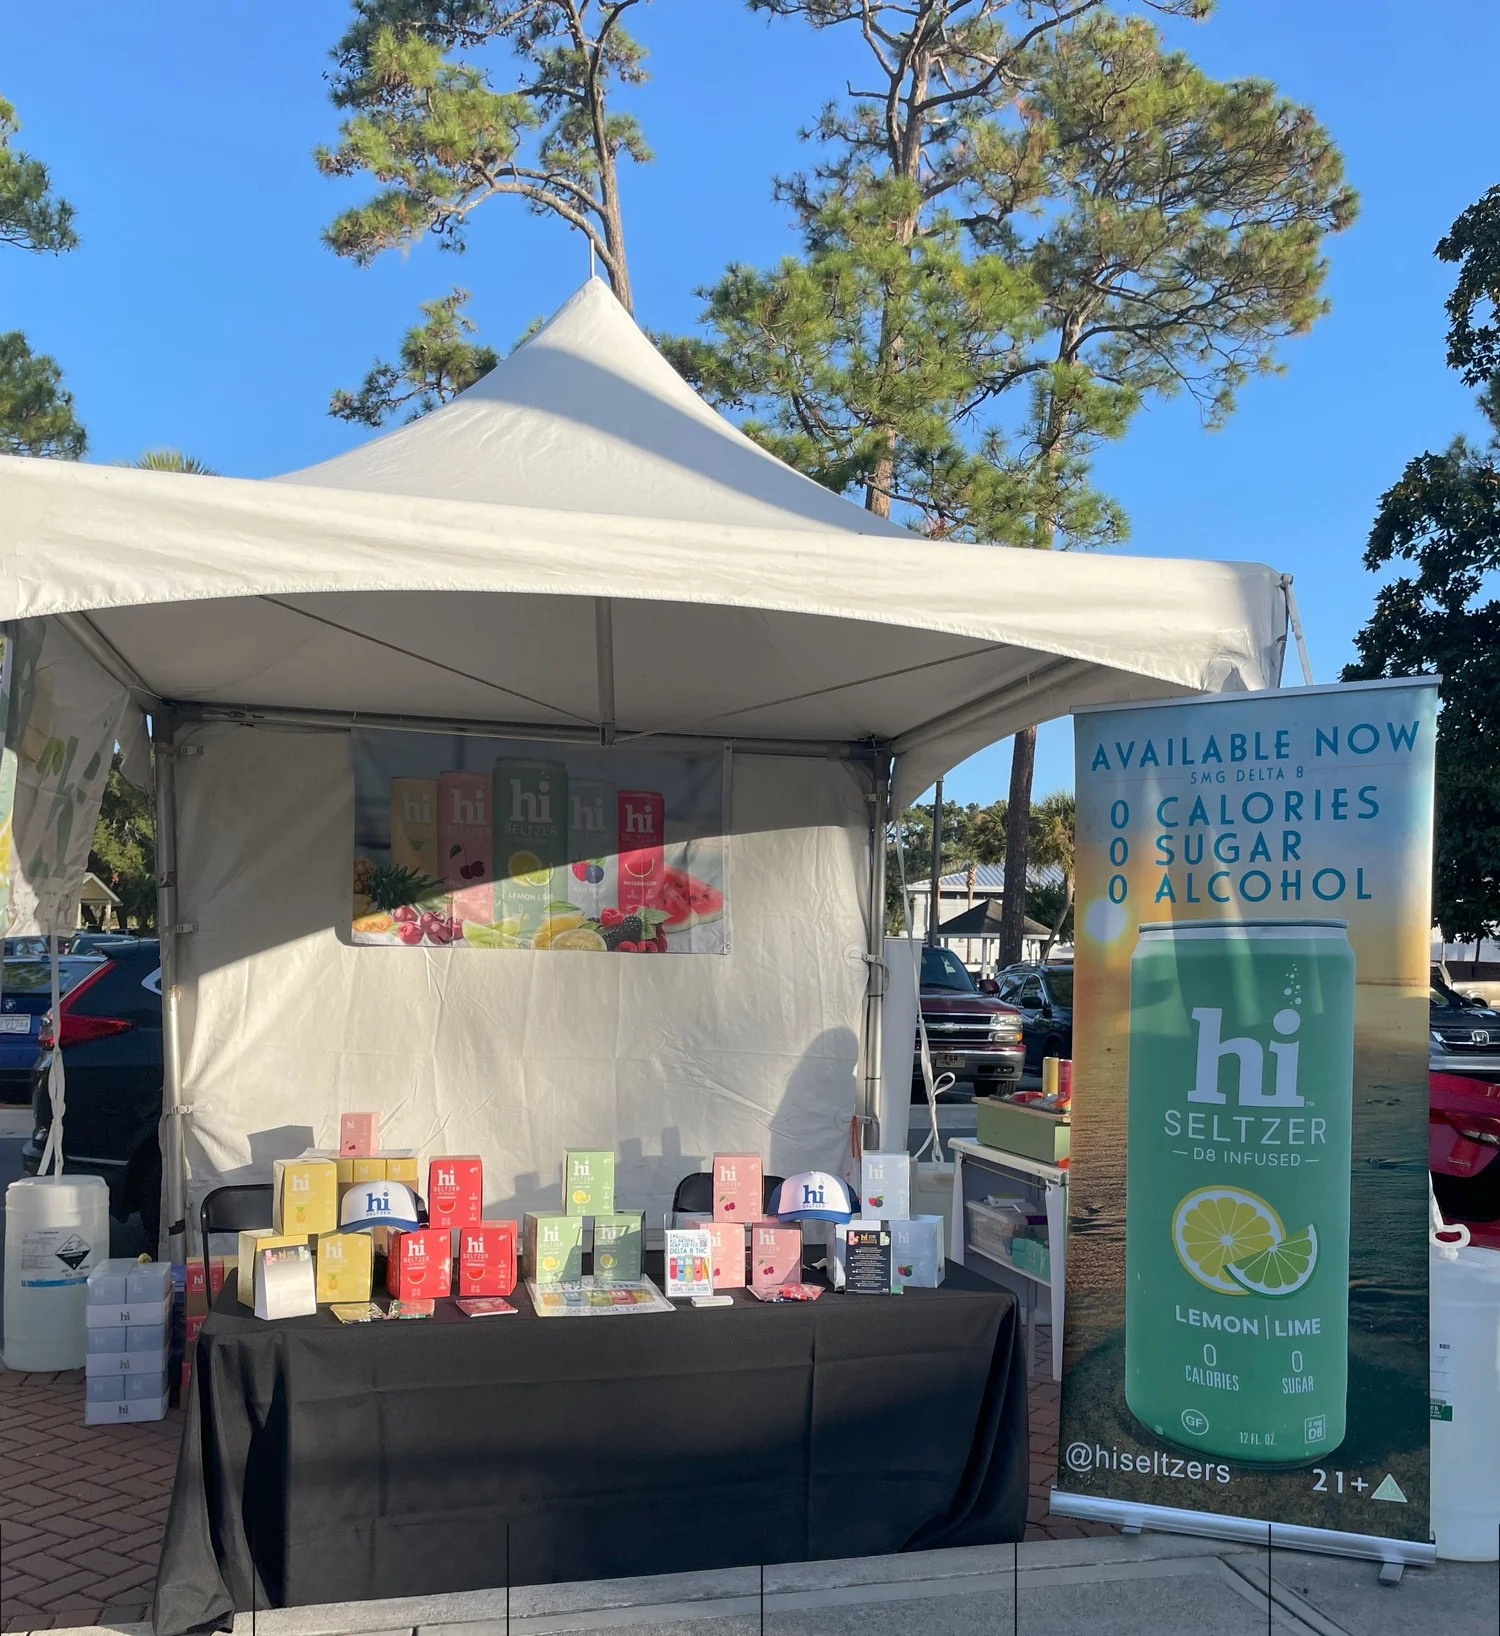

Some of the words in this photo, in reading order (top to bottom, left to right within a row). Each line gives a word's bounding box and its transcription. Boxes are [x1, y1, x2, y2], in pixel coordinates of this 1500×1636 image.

[1092, 730, 1290, 771] AVAILABLE
[1315, 720, 1420, 757] NOW
[1190, 770, 1226, 784] 5MG
[1236, 767, 1285, 782] DELTA
[1296, 766, 1304, 778] 8
[402, 792, 432, 824] hi
[451, 788, 489, 825] hi
[509, 779, 552, 823] hi
[1110, 800, 1129, 830] 0
[1157, 785, 1379, 828] CALORIES
[571, 795, 606, 831] hi
[625, 804, 653, 833] hi
[504, 824, 558, 837] SELTZER
[1109, 837, 1128, 866] 0
[1155, 830, 1302, 866] SUGAR
[1108, 874, 1127, 904] 0
[1155, 868, 1371, 903] ALCOHOL
[508, 891, 536, 900] LEMON
[1187, 1007, 1306, 1107] hi
[1164, 1109, 1326, 1145] SELTZER
[1193, 1147, 1217, 1163] D8
[1223, 1150, 1301, 1167] INFUSED
[573, 1160, 590, 1176] hi
[720, 1165, 737, 1181] hi
[868, 1164, 885, 1179] hi
[292, 1174, 309, 1191] hi
[437, 1169, 456, 1186] hi
[366, 1191, 391, 1212] hi
[803, 1184, 825, 1204] hi
[543, 1225, 560, 1242] hi
[759, 1229, 776, 1245] hi
[898, 1231, 910, 1244] hi
[325, 1241, 343, 1258] hi
[407, 1239, 426, 1257] hi
[467, 1236, 485, 1253] hi
[194, 1275, 204, 1284] hi
[94, 1286, 104, 1296] hi
[133, 1284, 143, 1294] hi
[120, 1311, 130, 1322] hi
[1175, 1305, 1258, 1335] LEMON
[1275, 1318, 1321, 1336] LIME
[120, 1359, 130, 1370] hi
[1203, 1344, 1217, 1366] 0
[1292, 1351, 1303, 1372] 0
[1185, 1365, 1239, 1391] CALORIES
[1282, 1376, 1314, 1394] SUGAR
[119, 1405, 129, 1415] hi
[1185, 1416, 1203, 1428] GF
[1240, 1432, 1249, 1444] 12
[1308, 1427, 1323, 1440] D8
[1066, 1442, 1230, 1483] @hiseltzers
[1313, 1468, 1368, 1493] 21+
